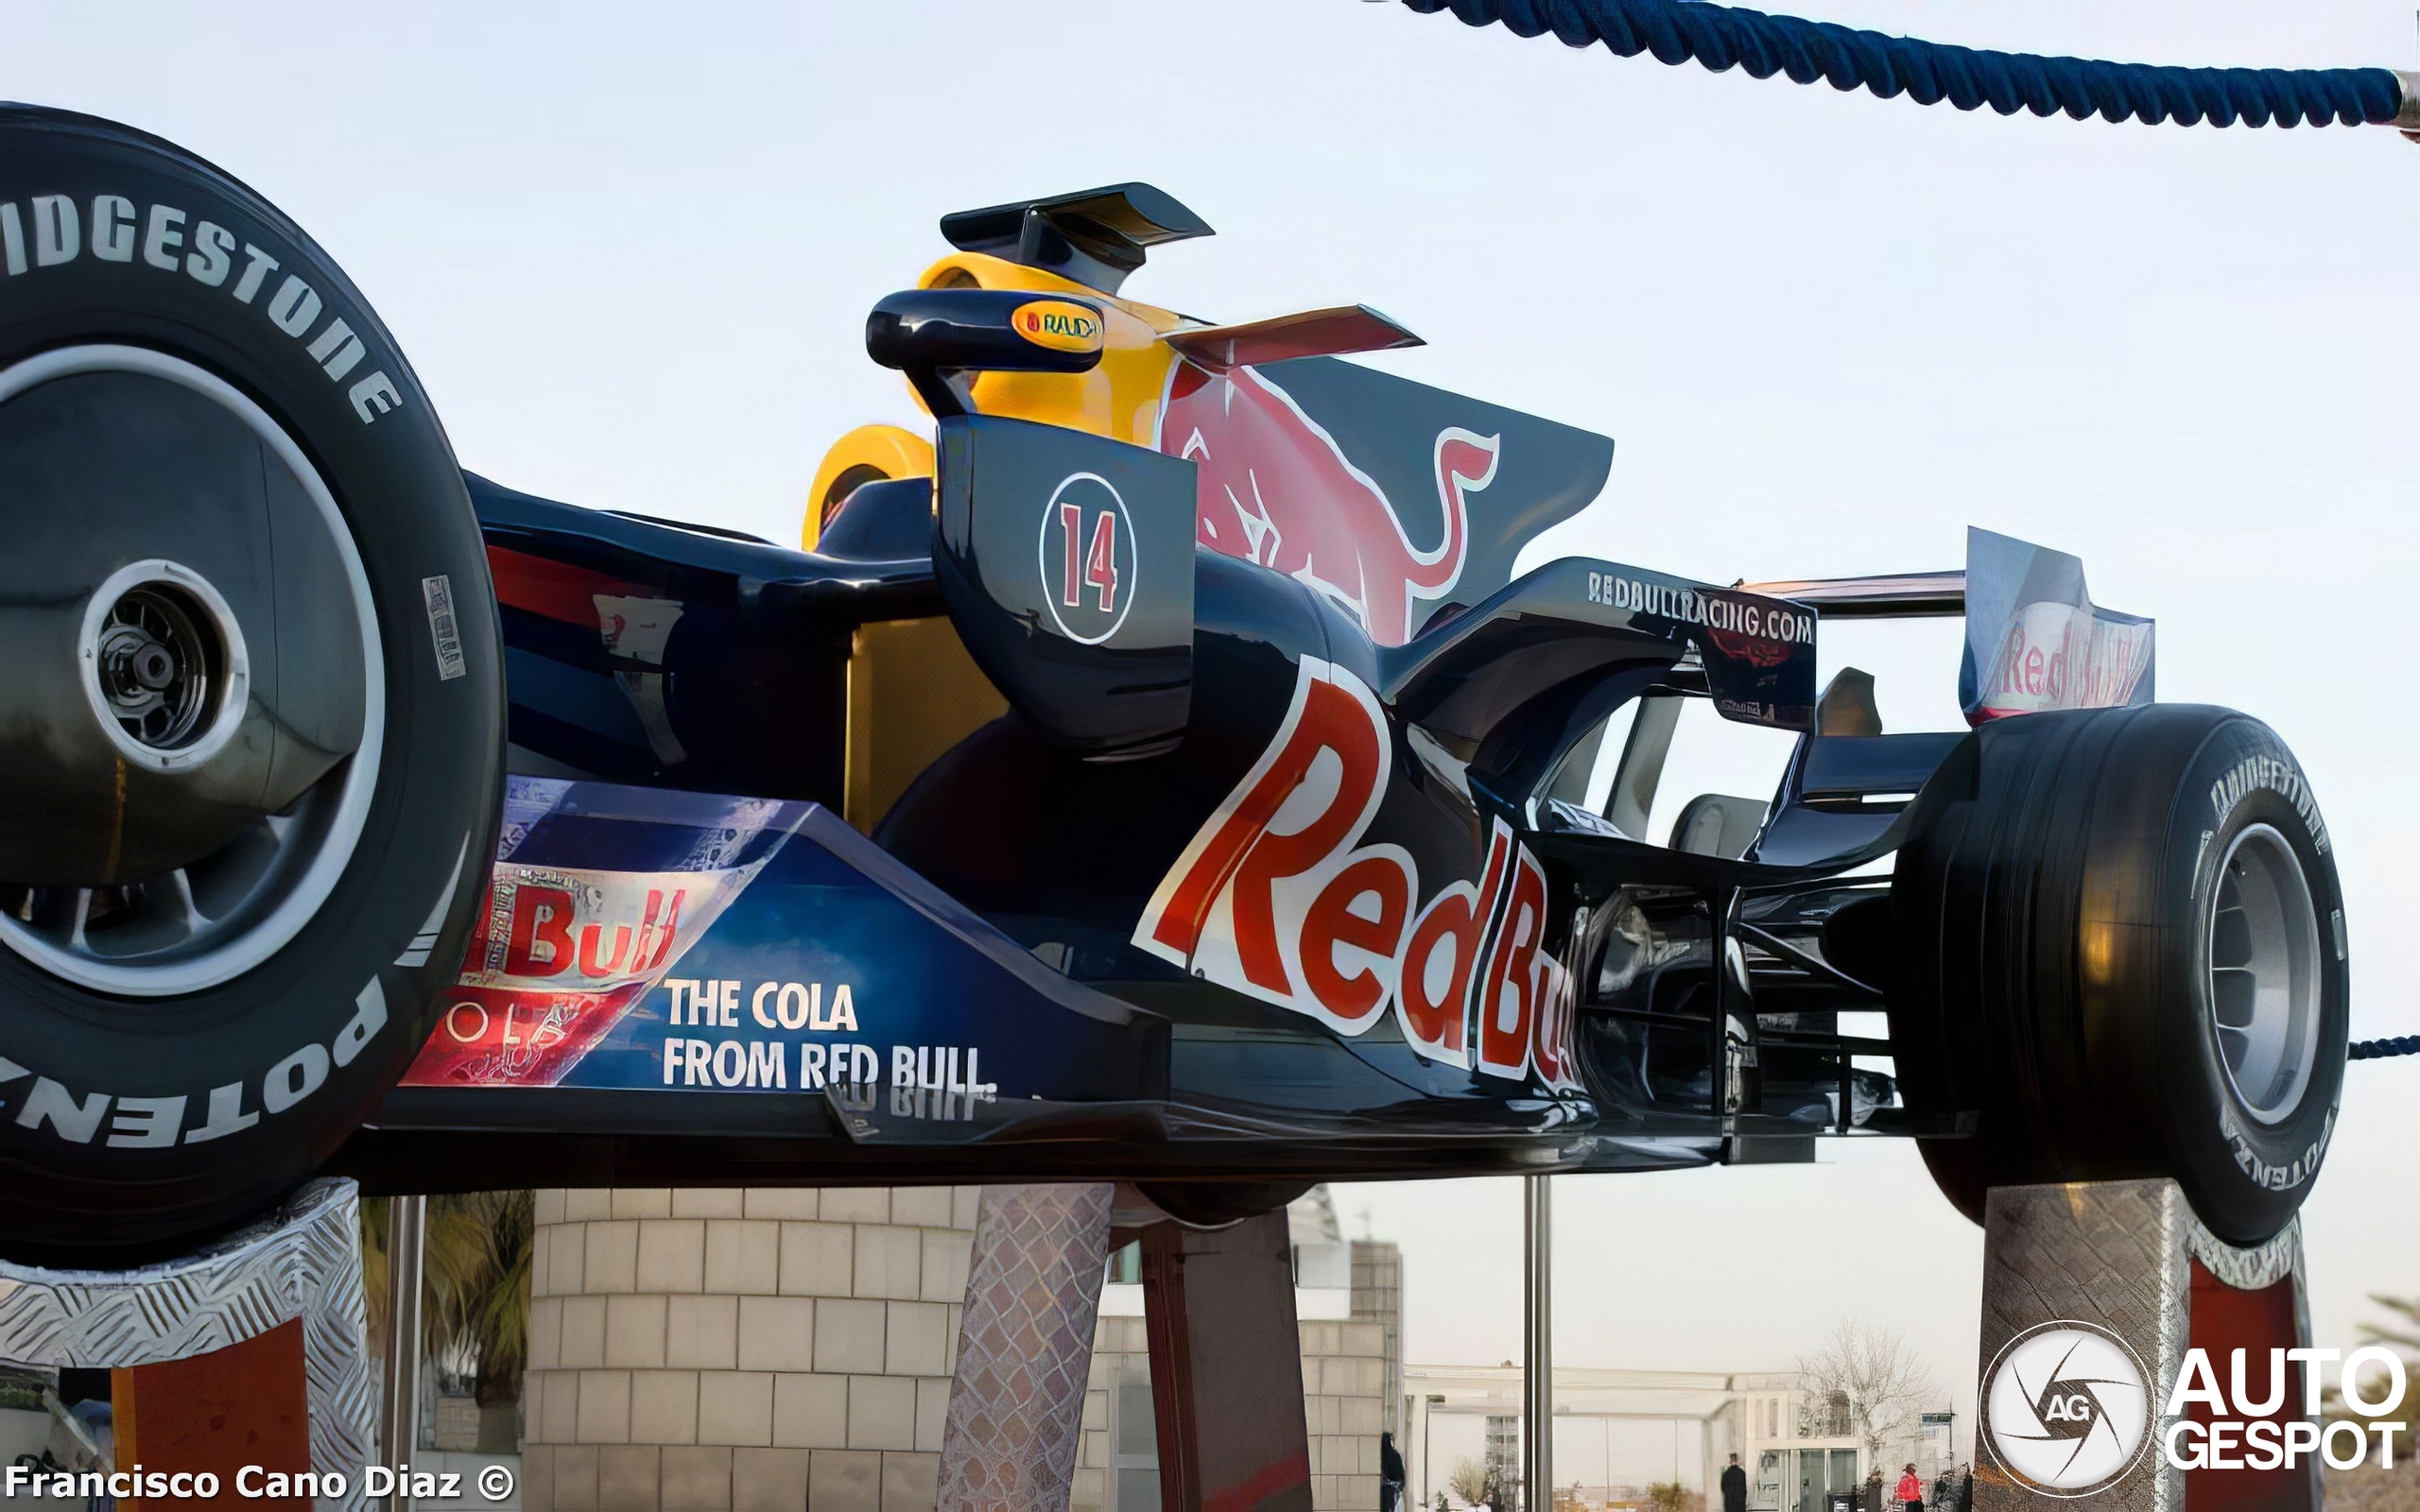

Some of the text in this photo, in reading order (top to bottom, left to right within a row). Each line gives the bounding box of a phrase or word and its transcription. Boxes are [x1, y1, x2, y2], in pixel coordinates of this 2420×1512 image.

[1060, 502, 1117, 613] 14
[1588, 572, 1812, 644] REDBULLRACING.COM
[1132, 654, 1588, 1092] Red Bu
[502, 888, 686, 979] Bull
[664, 979, 858, 1032] THE COLA
[664, 1038, 786, 1090] FROM
[800, 1042, 880, 1090] RED
